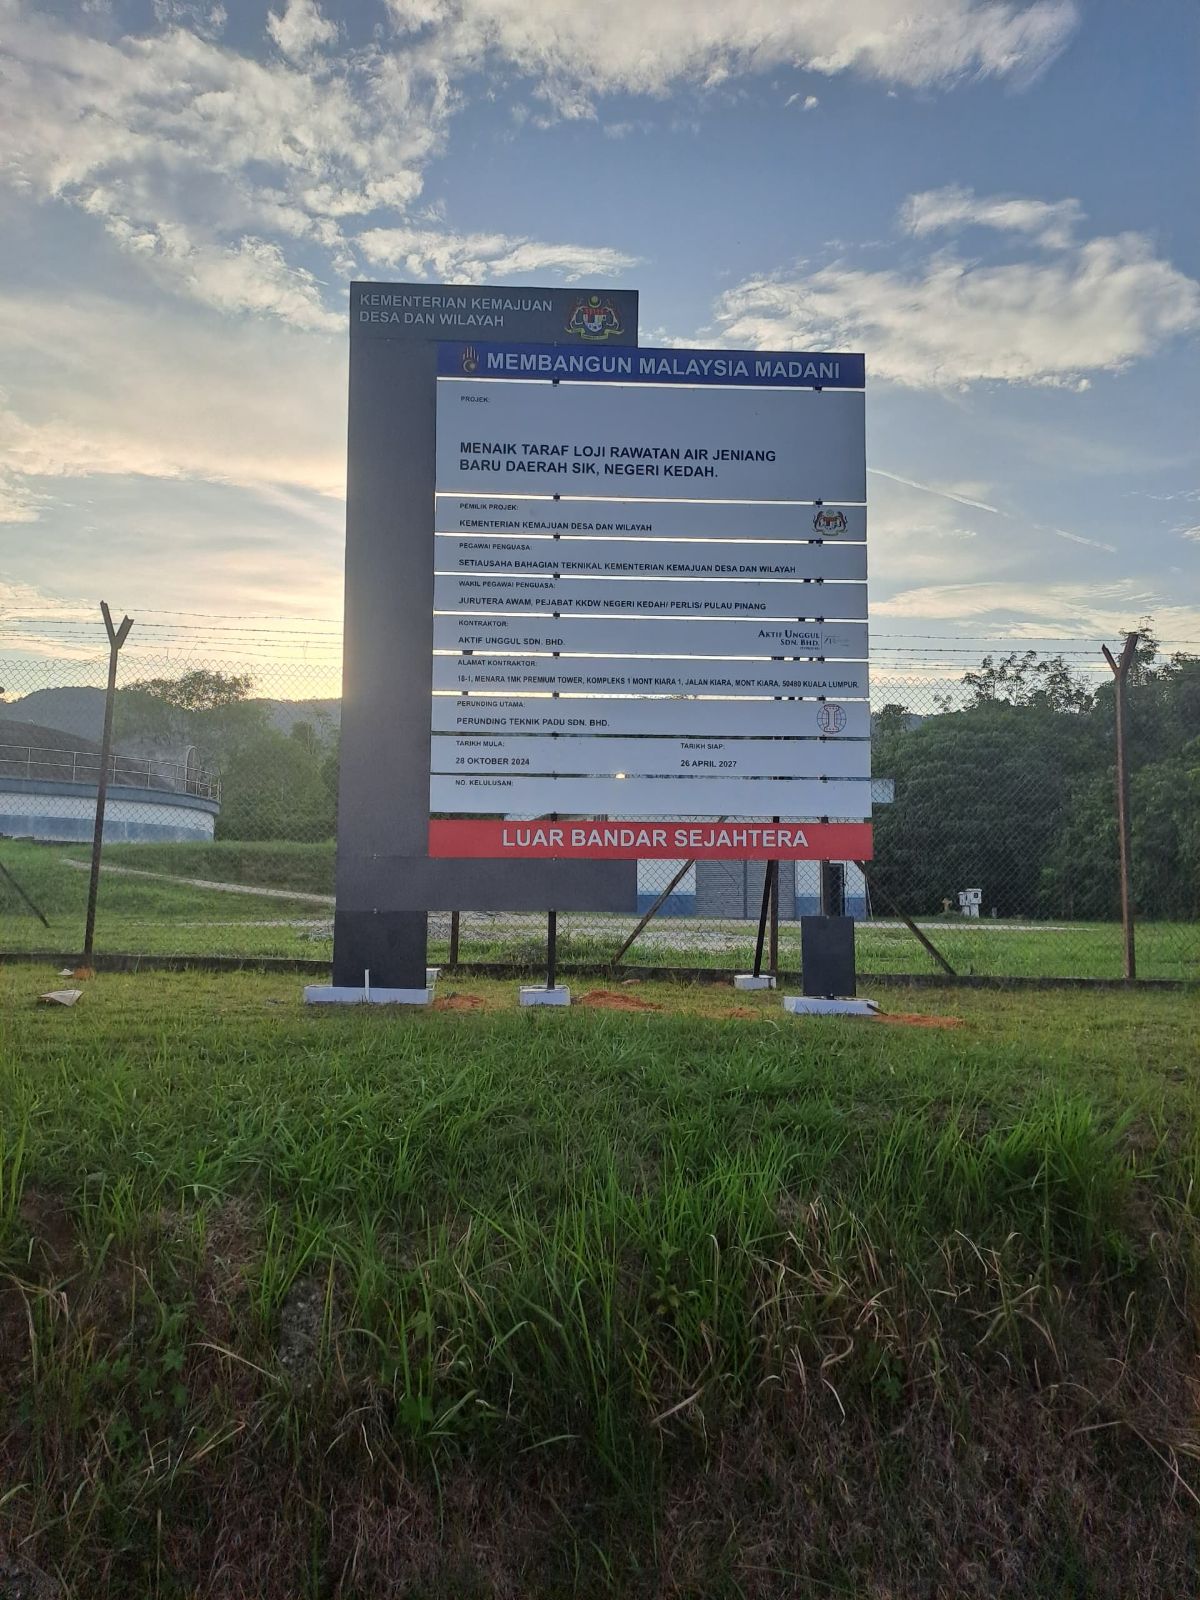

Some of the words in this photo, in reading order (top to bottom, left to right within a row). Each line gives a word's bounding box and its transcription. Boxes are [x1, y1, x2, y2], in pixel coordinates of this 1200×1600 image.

[360, 294, 466, 309] KEMENTERIAN
[471, 298, 552, 312] KEMAJUAN
[360, 311, 400, 323] DESA
[404, 313, 435, 324] DAN
[440, 314, 504, 327] WILAYAH
[487, 352, 632, 374] MEMBANGUN
[639, 357, 749, 377] MALAYSIA
[755, 360, 840, 379] MADANI
[460, 442, 516, 454] MENAIK
[521, 444, 569, 457] TARAF
[574, 445, 605, 458] LOJI
[610, 446, 680, 460] RAWATAN
[683, 449, 709, 461] AIR
[712, 449, 776, 462] JENIANG
[460, 459, 501, 472] BARU
[506, 460, 567, 474] DAERAH
[572, 462, 600, 476] SIK,
[605, 464, 659, 476] NEGERI
[664, 465, 718, 478] KEDAH.
[459, 559, 512, 567] SETIAUSAHA
[605, 562, 664, 571] KEMENTERIAN
[502, 829, 564, 847] LUAR
[572, 829, 666, 848] BANDAR
[675, 830, 808, 848] SEJAHTERA
